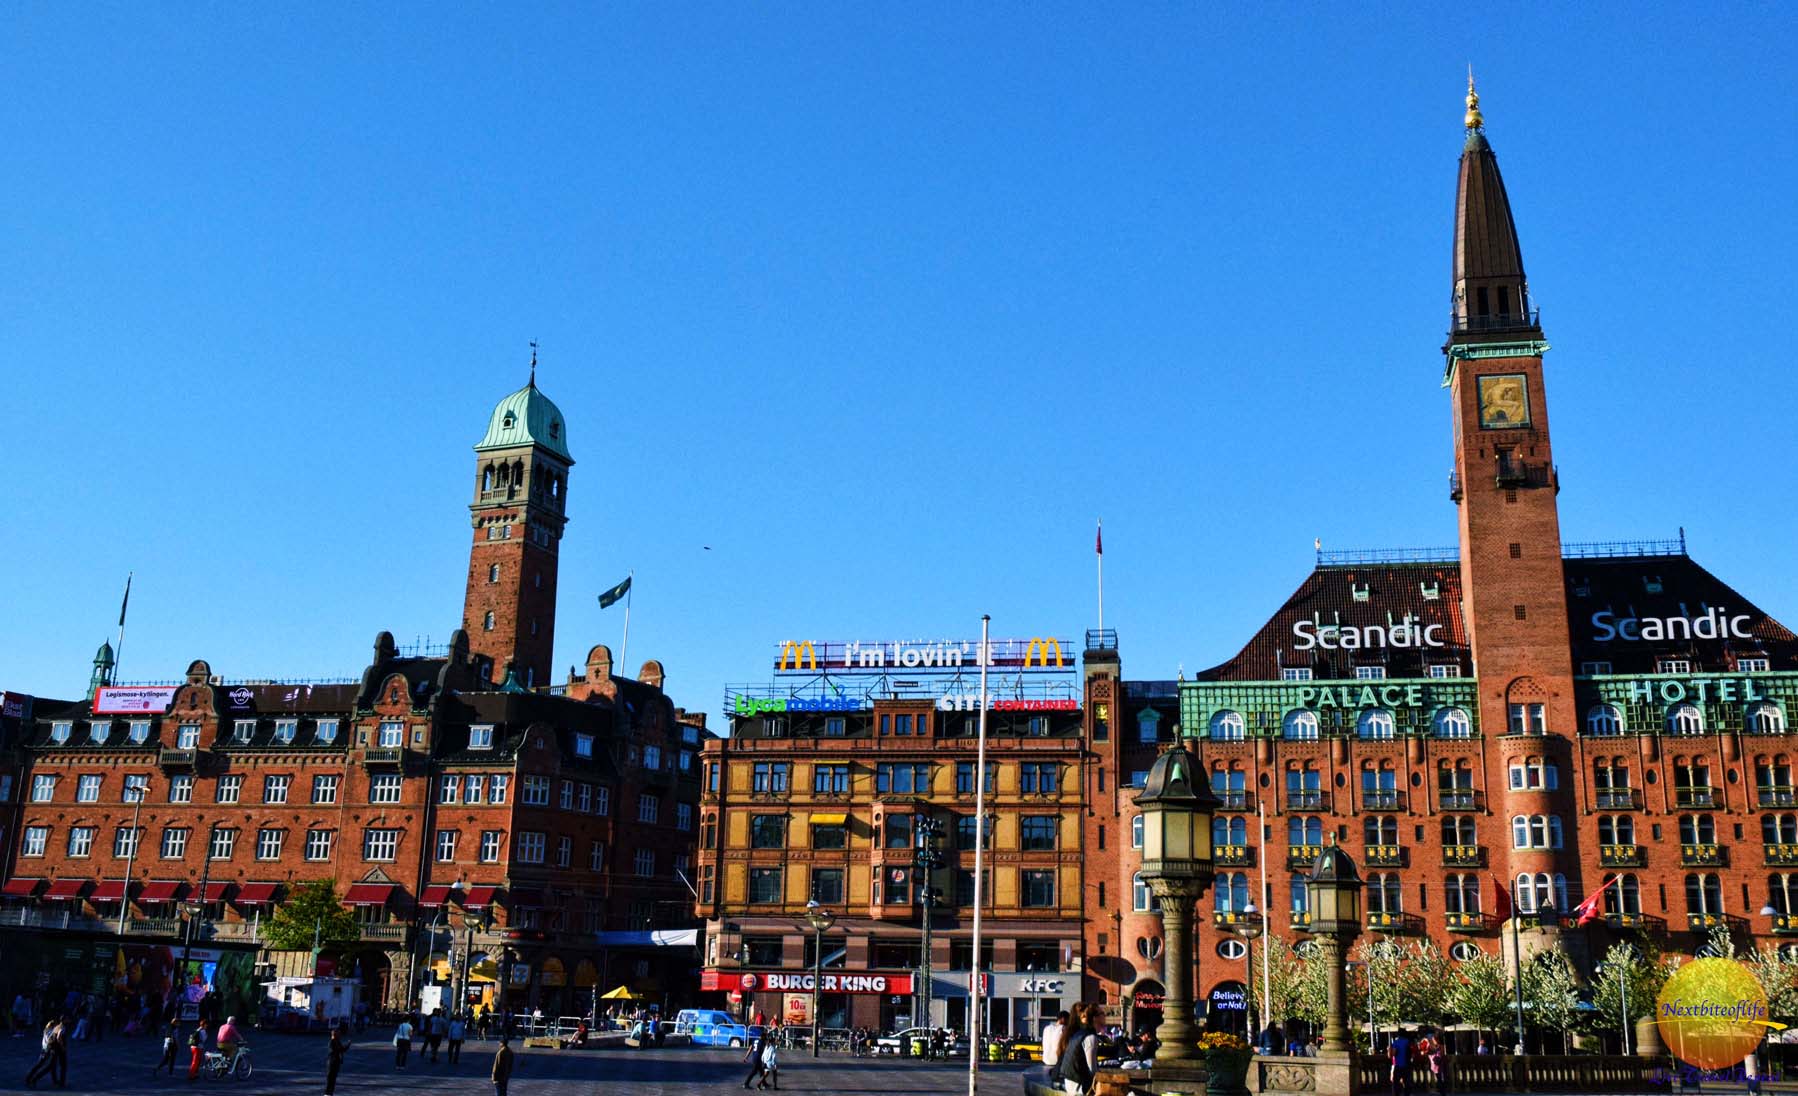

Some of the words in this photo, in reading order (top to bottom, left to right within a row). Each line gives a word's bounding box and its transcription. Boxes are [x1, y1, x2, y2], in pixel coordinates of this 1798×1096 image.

[1293, 616, 1445, 650] Scandic
[1591, 606, 1753, 641] Scandic
[845, 641, 885, 667] i'm
[894, 643, 968, 667] lovin'
[1300, 685, 1423, 708] PALACE
[1630, 678, 1763, 703] HOTEL
[735, 694, 861, 717] Lycamobile
[940, 694, 995, 711] CITY
[994, 699, 1078, 712] CONTAINER
[767, 974, 837, 991] BURGER
[840, 975, 886, 992] KING
[1020, 978, 1065, 993] KFC
[790, 1000, 800, 1010] 10
